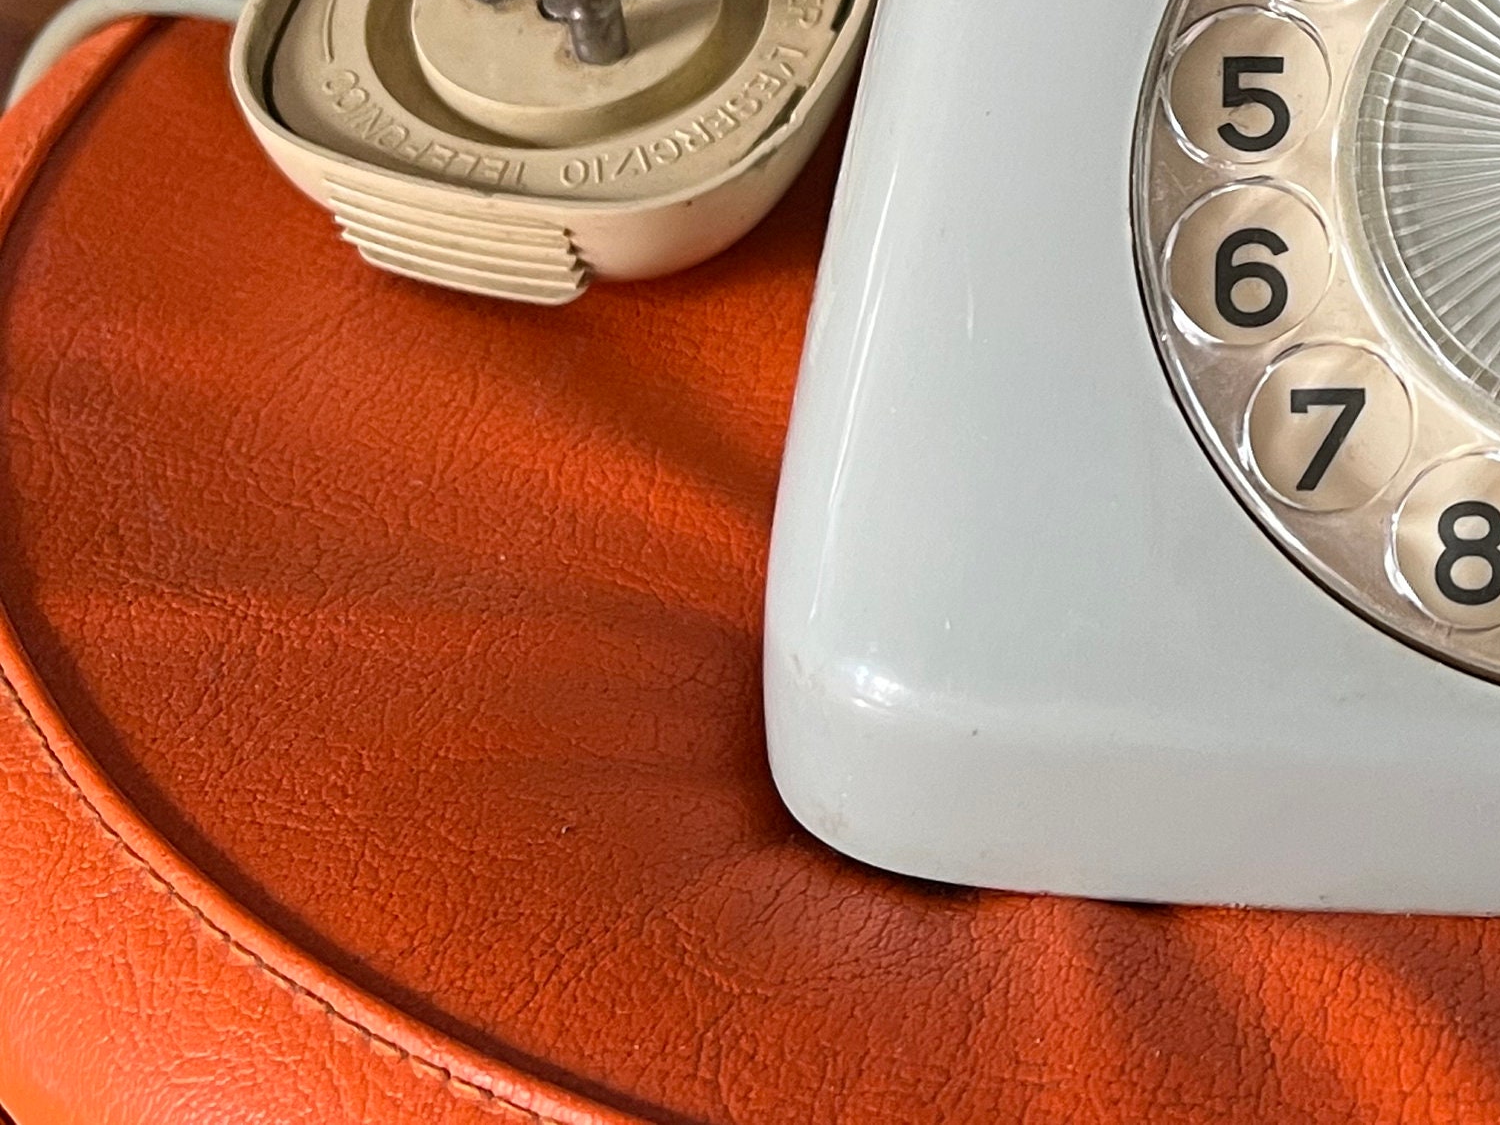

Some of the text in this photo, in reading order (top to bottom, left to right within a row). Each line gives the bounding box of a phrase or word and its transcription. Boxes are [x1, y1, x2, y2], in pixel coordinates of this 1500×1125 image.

[321, 69, 526, 188] TELEFONICO
[559, 45, 807, 188] L'ESERCIZIO
[1215, 54, 1292, 154] 5
[1213, 226, 1290, 330] 6
[1289, 386, 1367, 493] 7
